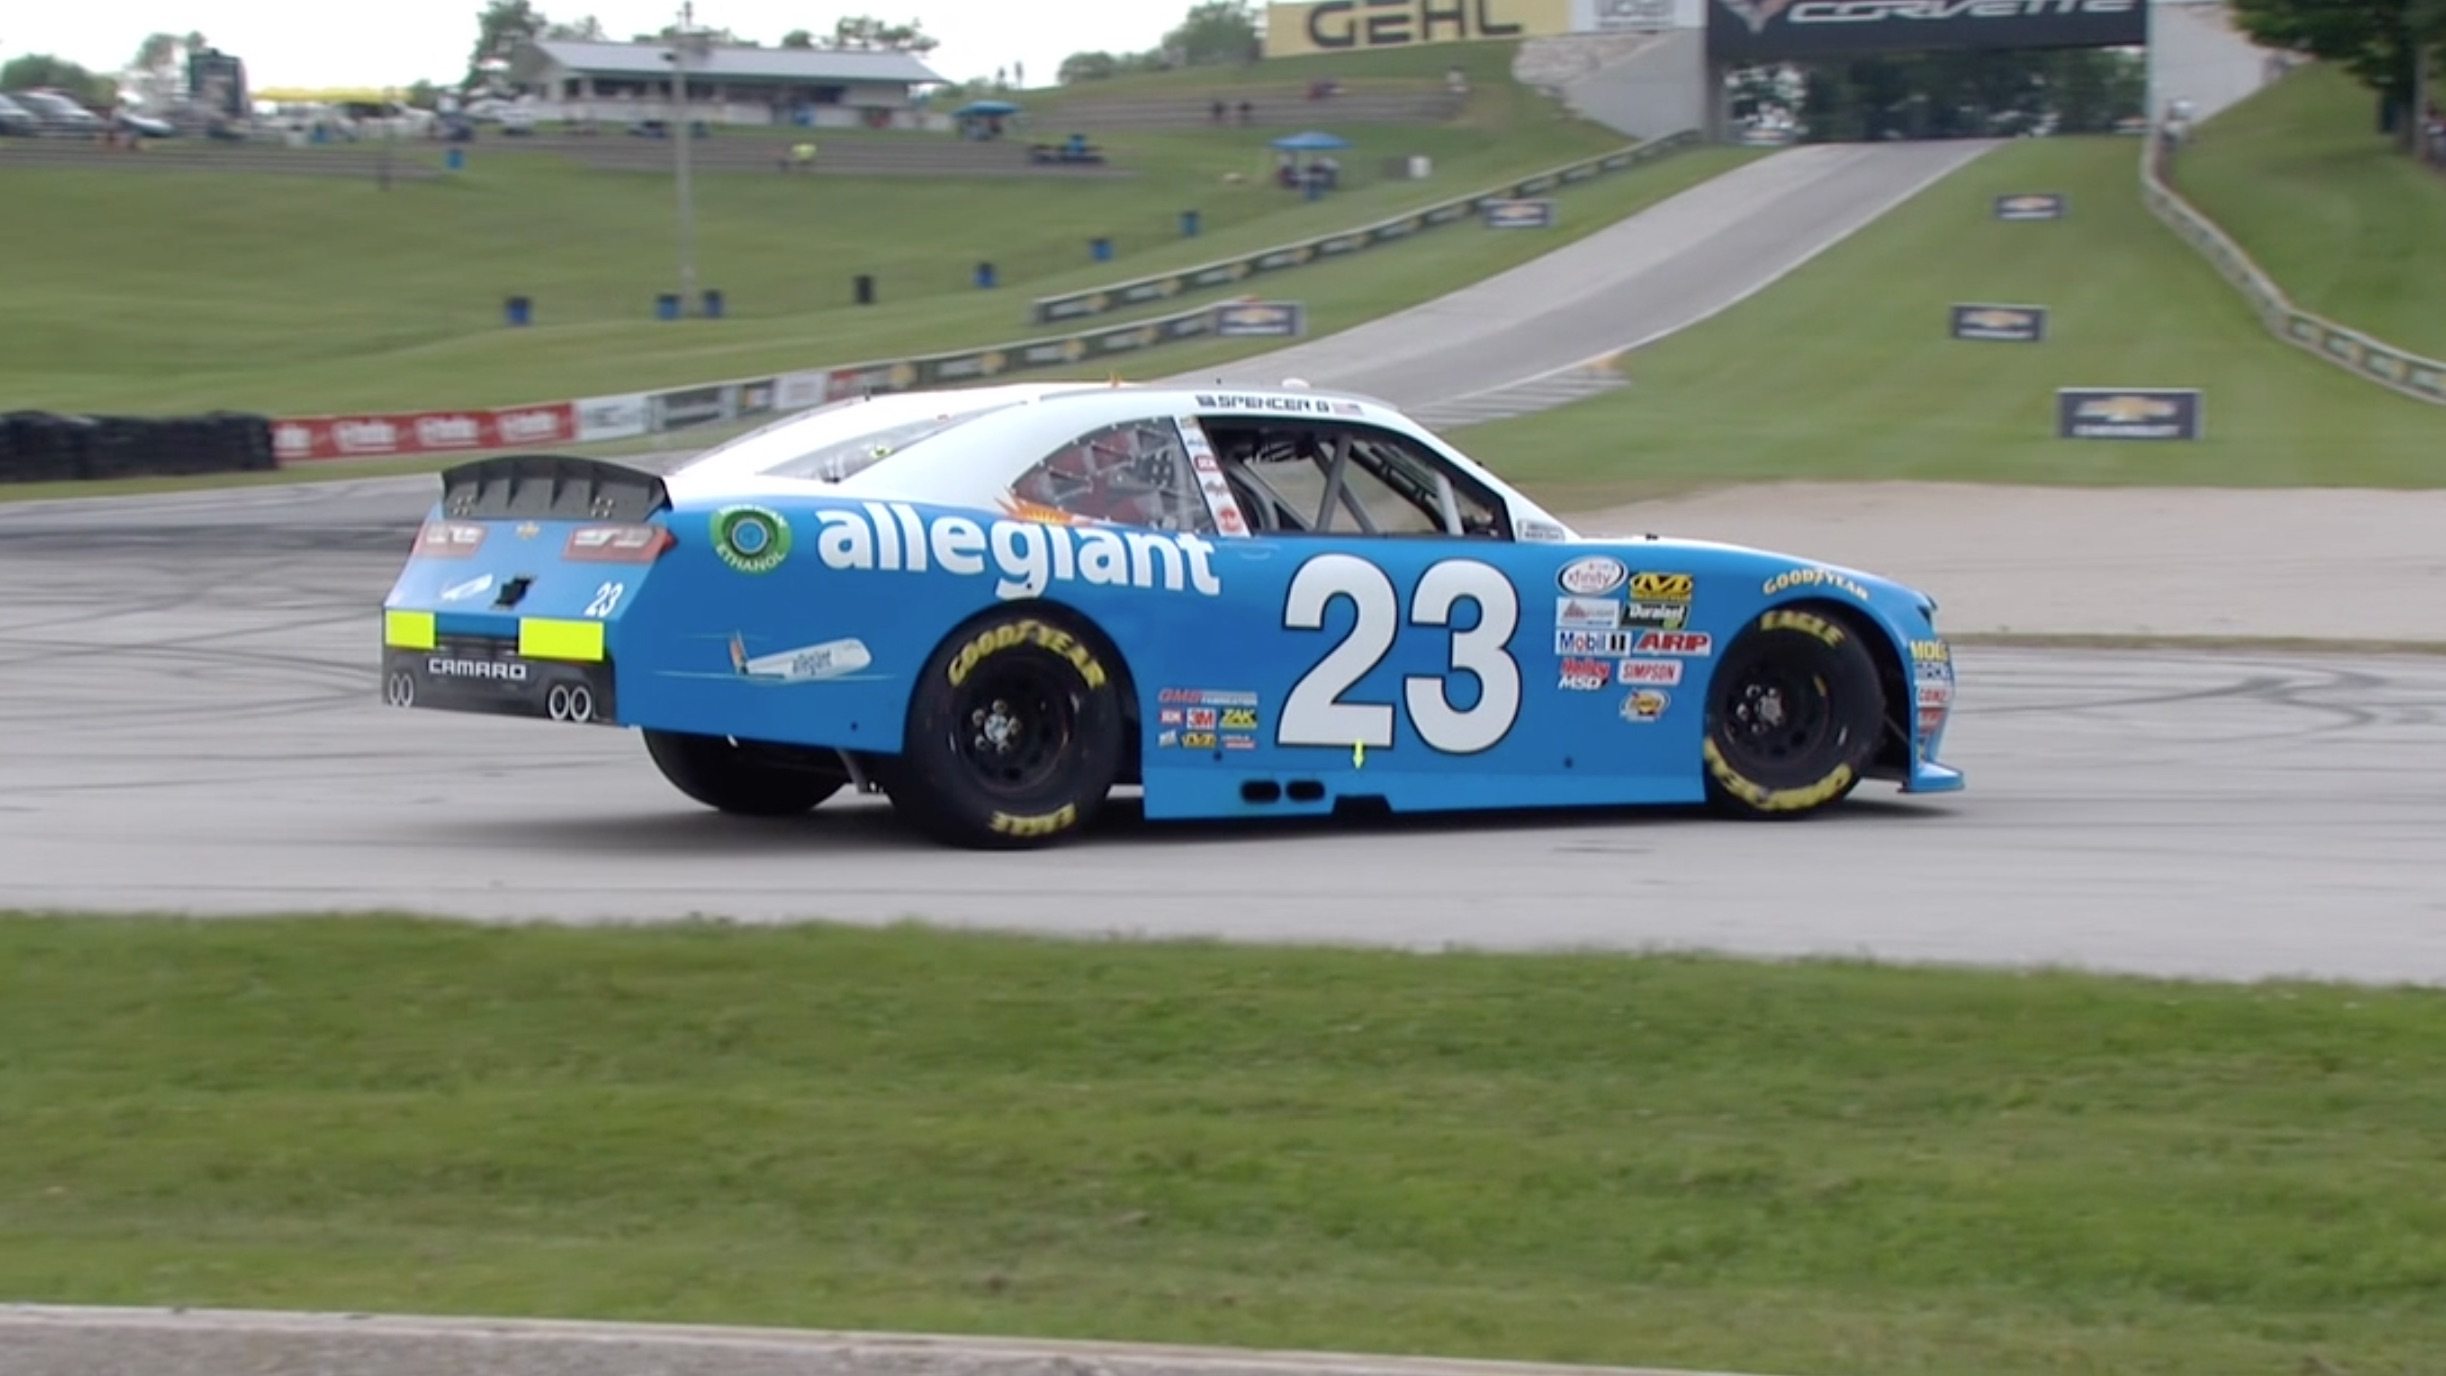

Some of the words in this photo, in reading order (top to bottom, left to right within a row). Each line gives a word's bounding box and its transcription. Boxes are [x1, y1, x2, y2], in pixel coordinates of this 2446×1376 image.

[1308, 0, 1522, 48] GEHL
[1218, 394, 1311, 412] SPENCER
[715, 542, 787, 572] ETHANOL
[815, 502, 1221, 600] allegiant
[584, 581, 623, 617] 23
[1763, 569, 1869, 600] GOODYEAR
[949, 618, 1107, 690] GOODYEAR
[1276, 553, 1523, 756] 23
[1560, 632, 1607, 652] Mobil
[1637, 633, 1709, 651] ARP
[428, 658, 526, 681] CAMARO
[1558, 675, 1604, 691] MSD
[1622, 662, 1675, 681] SIMPSON
